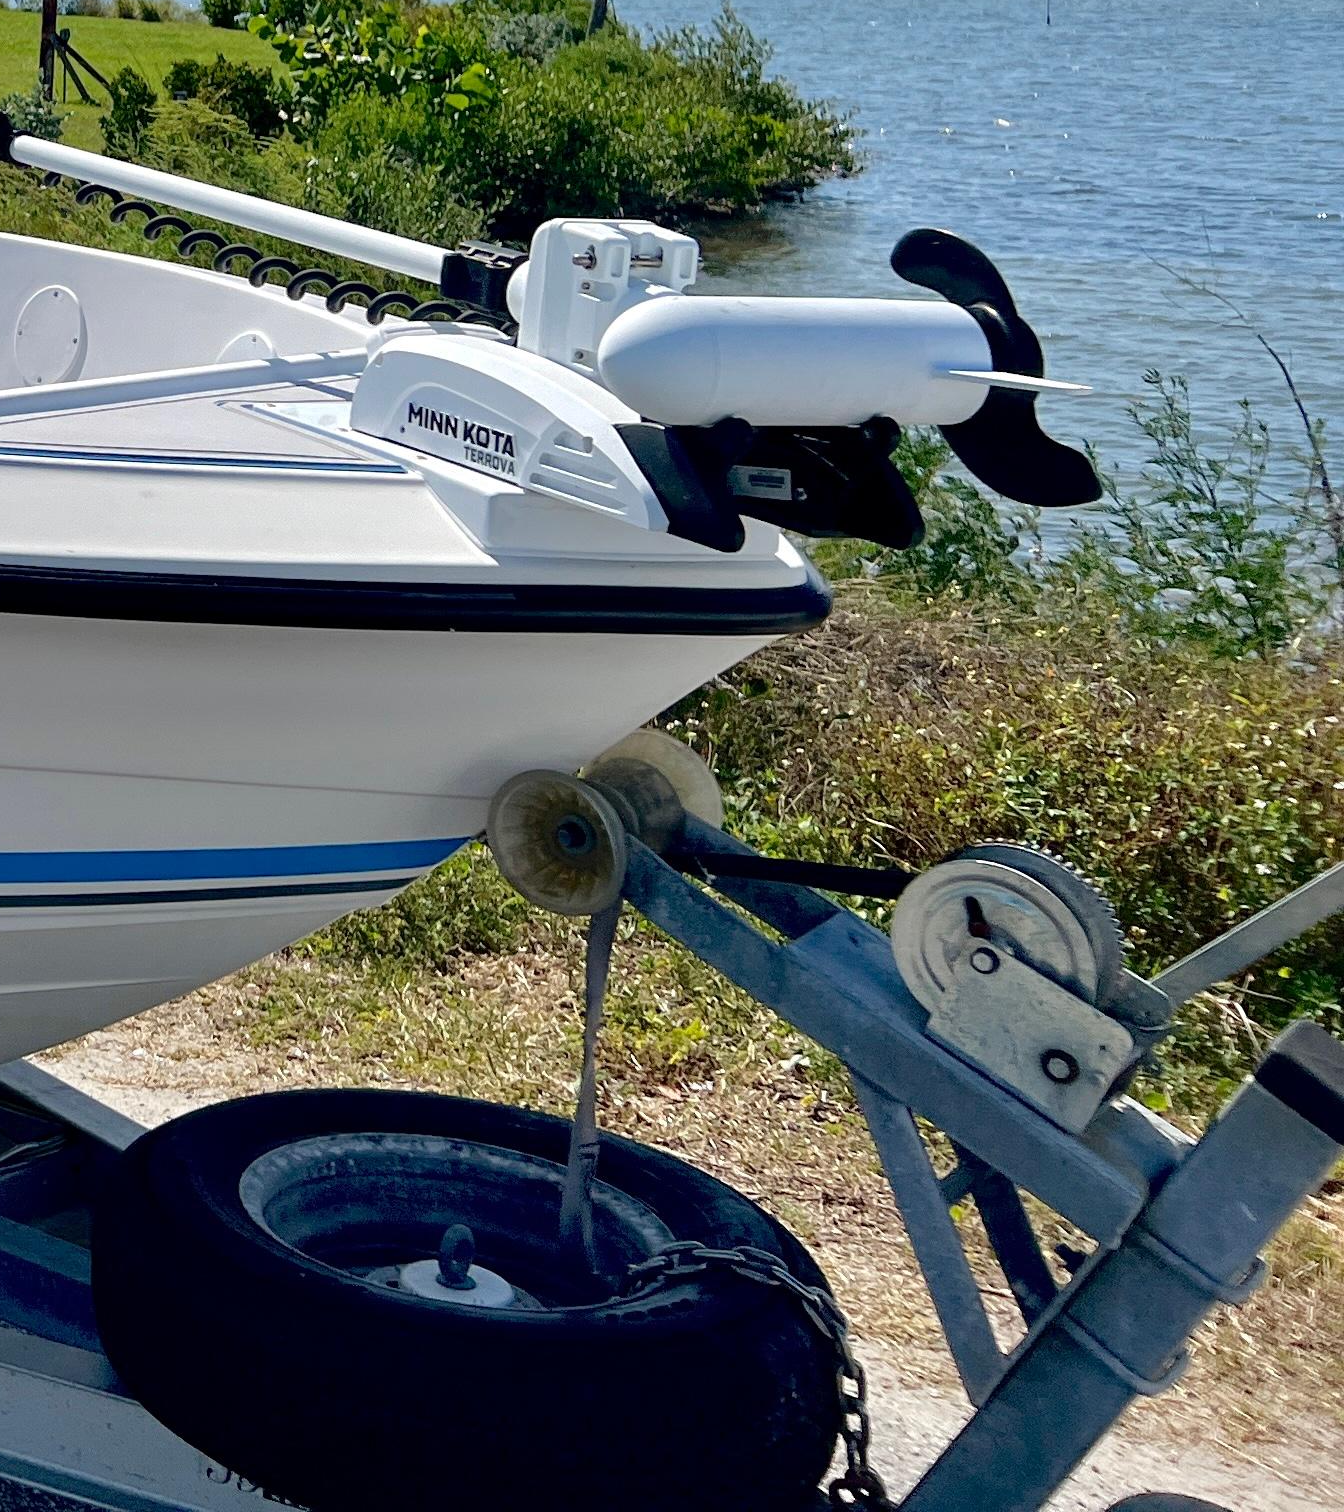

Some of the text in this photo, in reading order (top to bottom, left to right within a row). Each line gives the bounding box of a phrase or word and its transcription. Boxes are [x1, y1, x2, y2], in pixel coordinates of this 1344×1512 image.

[408, 402, 516, 458] MINN KOTA
[463, 445, 516, 477] TERROVA
